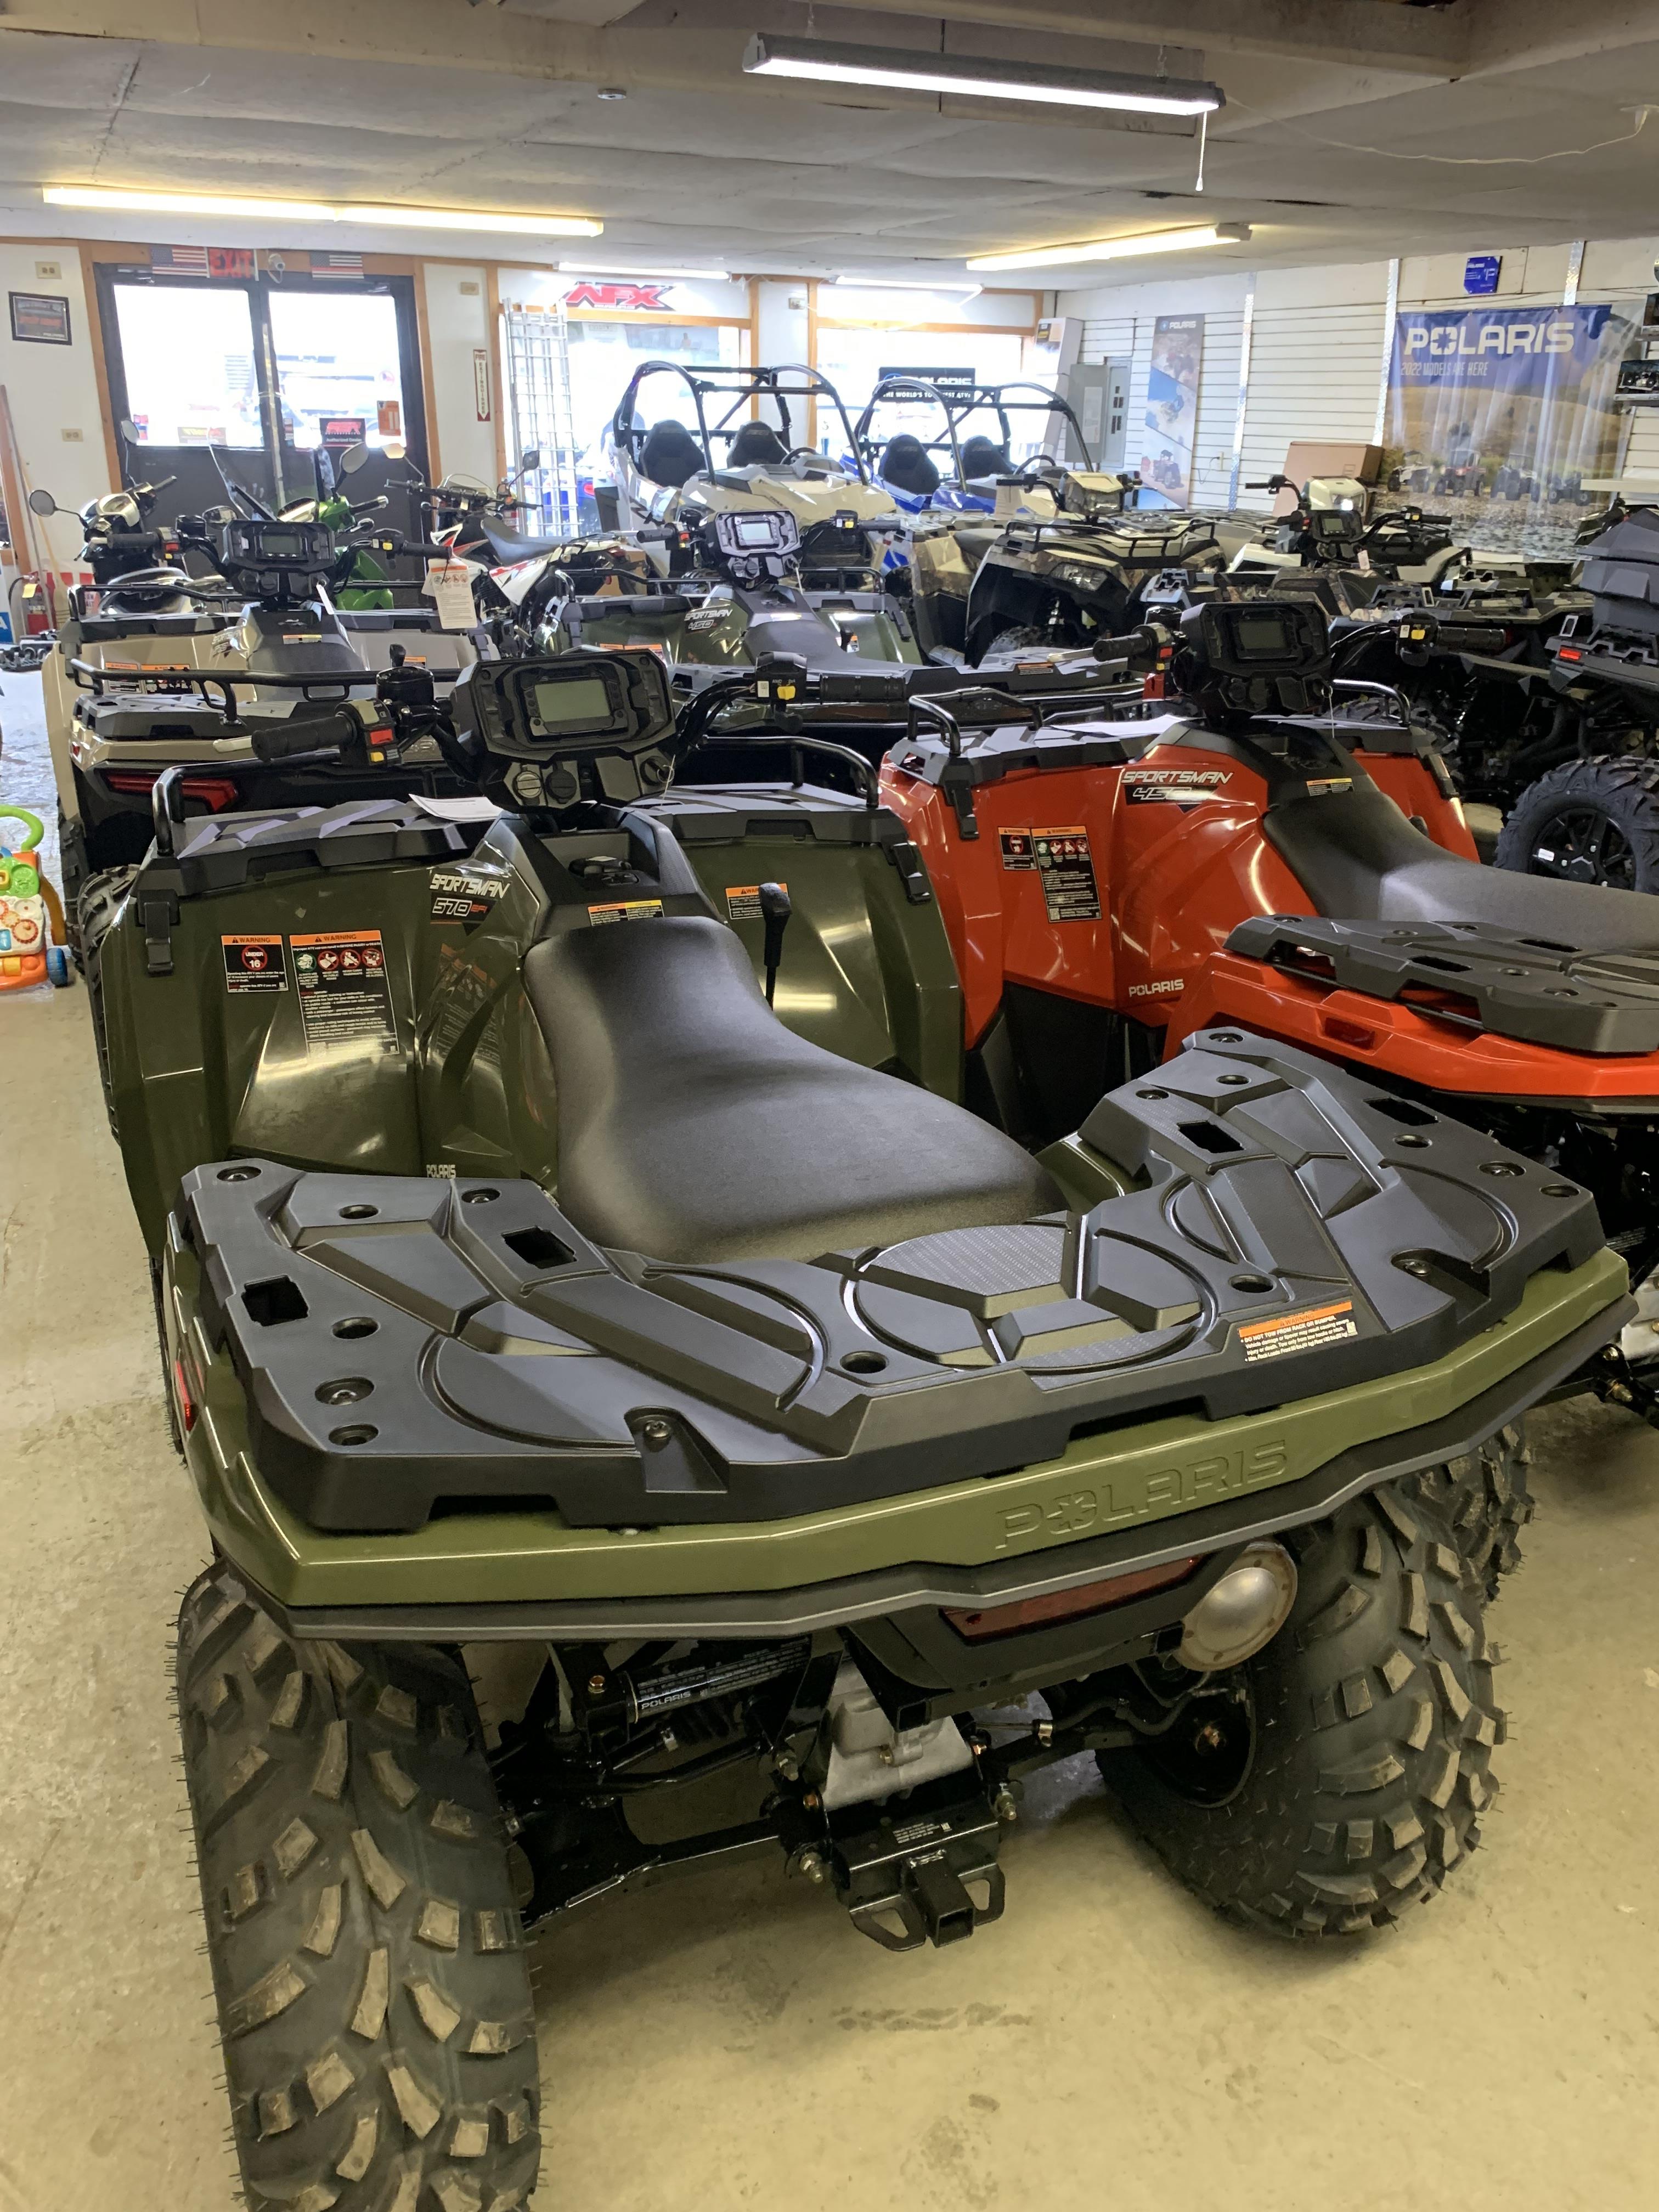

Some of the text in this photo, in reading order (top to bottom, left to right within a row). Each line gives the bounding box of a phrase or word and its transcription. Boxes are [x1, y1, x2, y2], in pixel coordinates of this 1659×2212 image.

[209, 249, 252, 278] EXIT
[565, 282, 666, 308] AFX
[1404, 323, 1575, 355] POLARIS
[1401, 363, 1422, 376] 2022
[1423, 362, 1452, 376] MODELS
[1467, 362, 1489, 376] HERE
[684, 609, 733, 621] SPORTSMAN
[688, 620, 714, 630] 450
[1121, 771, 1233, 783] SPORTSMAN
[430, 873, 510, 899] SPORTSMAN
[432, 898, 472, 917] 570
[249, 960, 262, 968] 16
[1128, 979, 1184, 997] POLARIS
[426, 1164, 456, 1178] POLARIS
[1286, 1313, 1315, 1325] WARNING
[1277, 1327, 1291, 1336] FROM
[995, 1439, 1288, 1550] POLARIS
[641, 1691, 692, 1710] POLARIS
